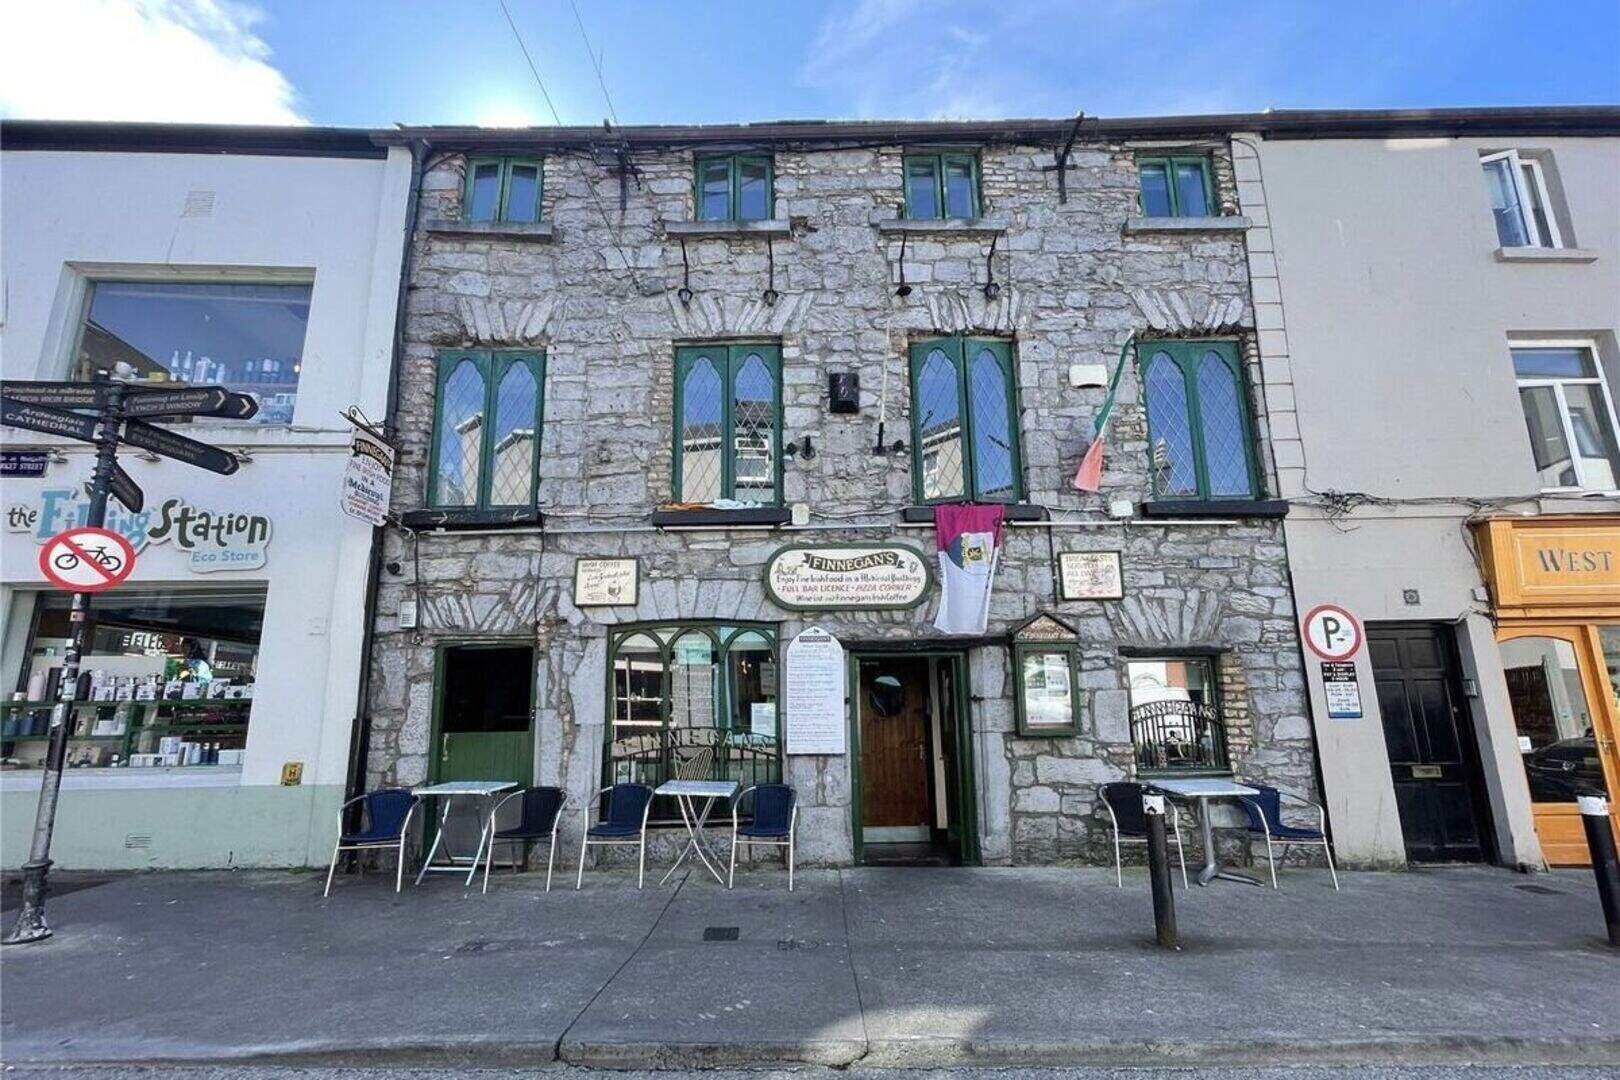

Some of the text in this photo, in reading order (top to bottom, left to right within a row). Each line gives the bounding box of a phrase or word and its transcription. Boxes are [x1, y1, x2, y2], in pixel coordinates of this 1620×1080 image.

[6, 413, 83, 434] CATHEDRAL
[9, 490, 267, 548] the Filing Station
[192, 551, 259, 562] Eco Store
[813, 553, 895, 571] FINNEGAN'S
[1538, 549, 1612, 572] WEST
[879, 584, 912, 592] CORNER
[1322, 617, 1340, 649] P
